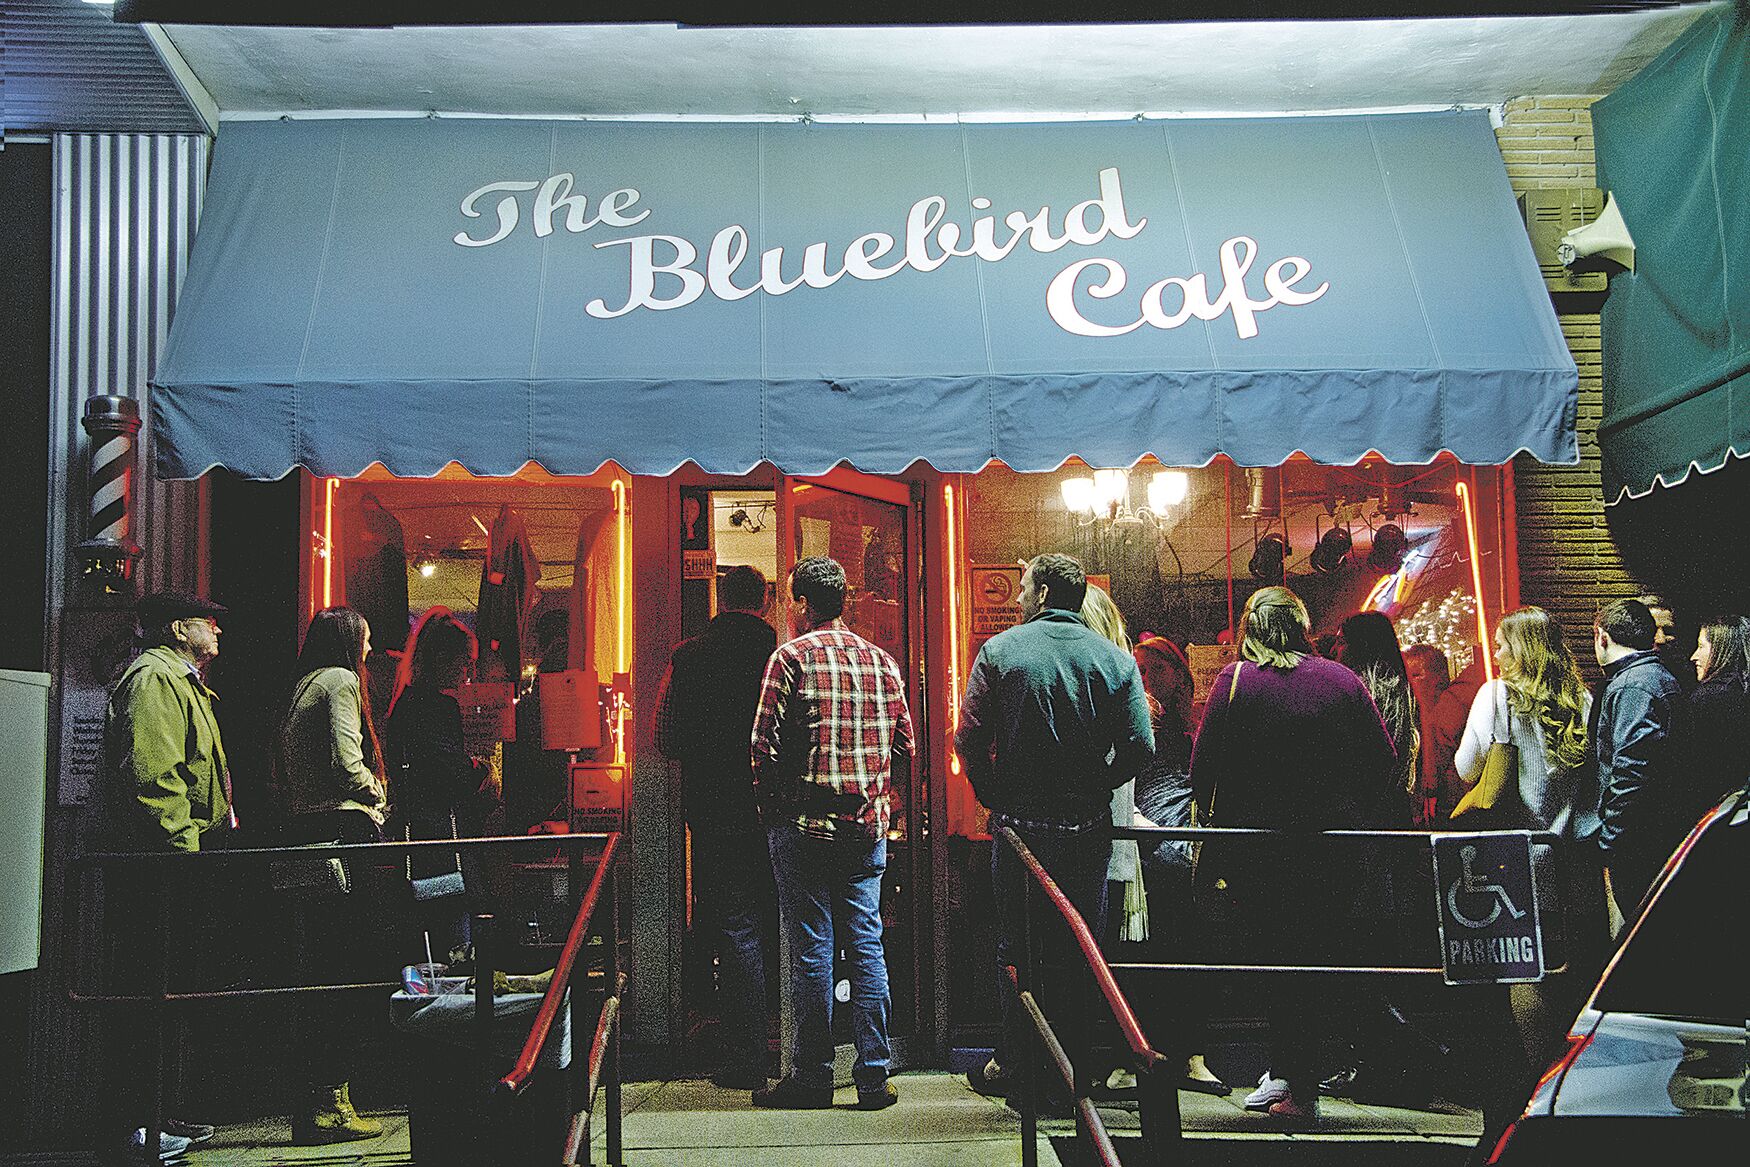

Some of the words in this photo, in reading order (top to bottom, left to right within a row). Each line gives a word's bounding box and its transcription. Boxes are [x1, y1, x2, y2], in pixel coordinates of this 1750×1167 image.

[453, 171, 651, 247] The
[585, 167, 1147, 320] Bluebird
[1046, 235, 1330, 339] Cafe
[975, 606, 985, 614] NO
[987, 606, 1020, 614] SMOKING
[978, 615, 988, 623] OR
[990, 615, 1018, 623] VAPING
[588, 807, 621, 815] SMOKING
[1449, 936, 1534, 966] PARKING
